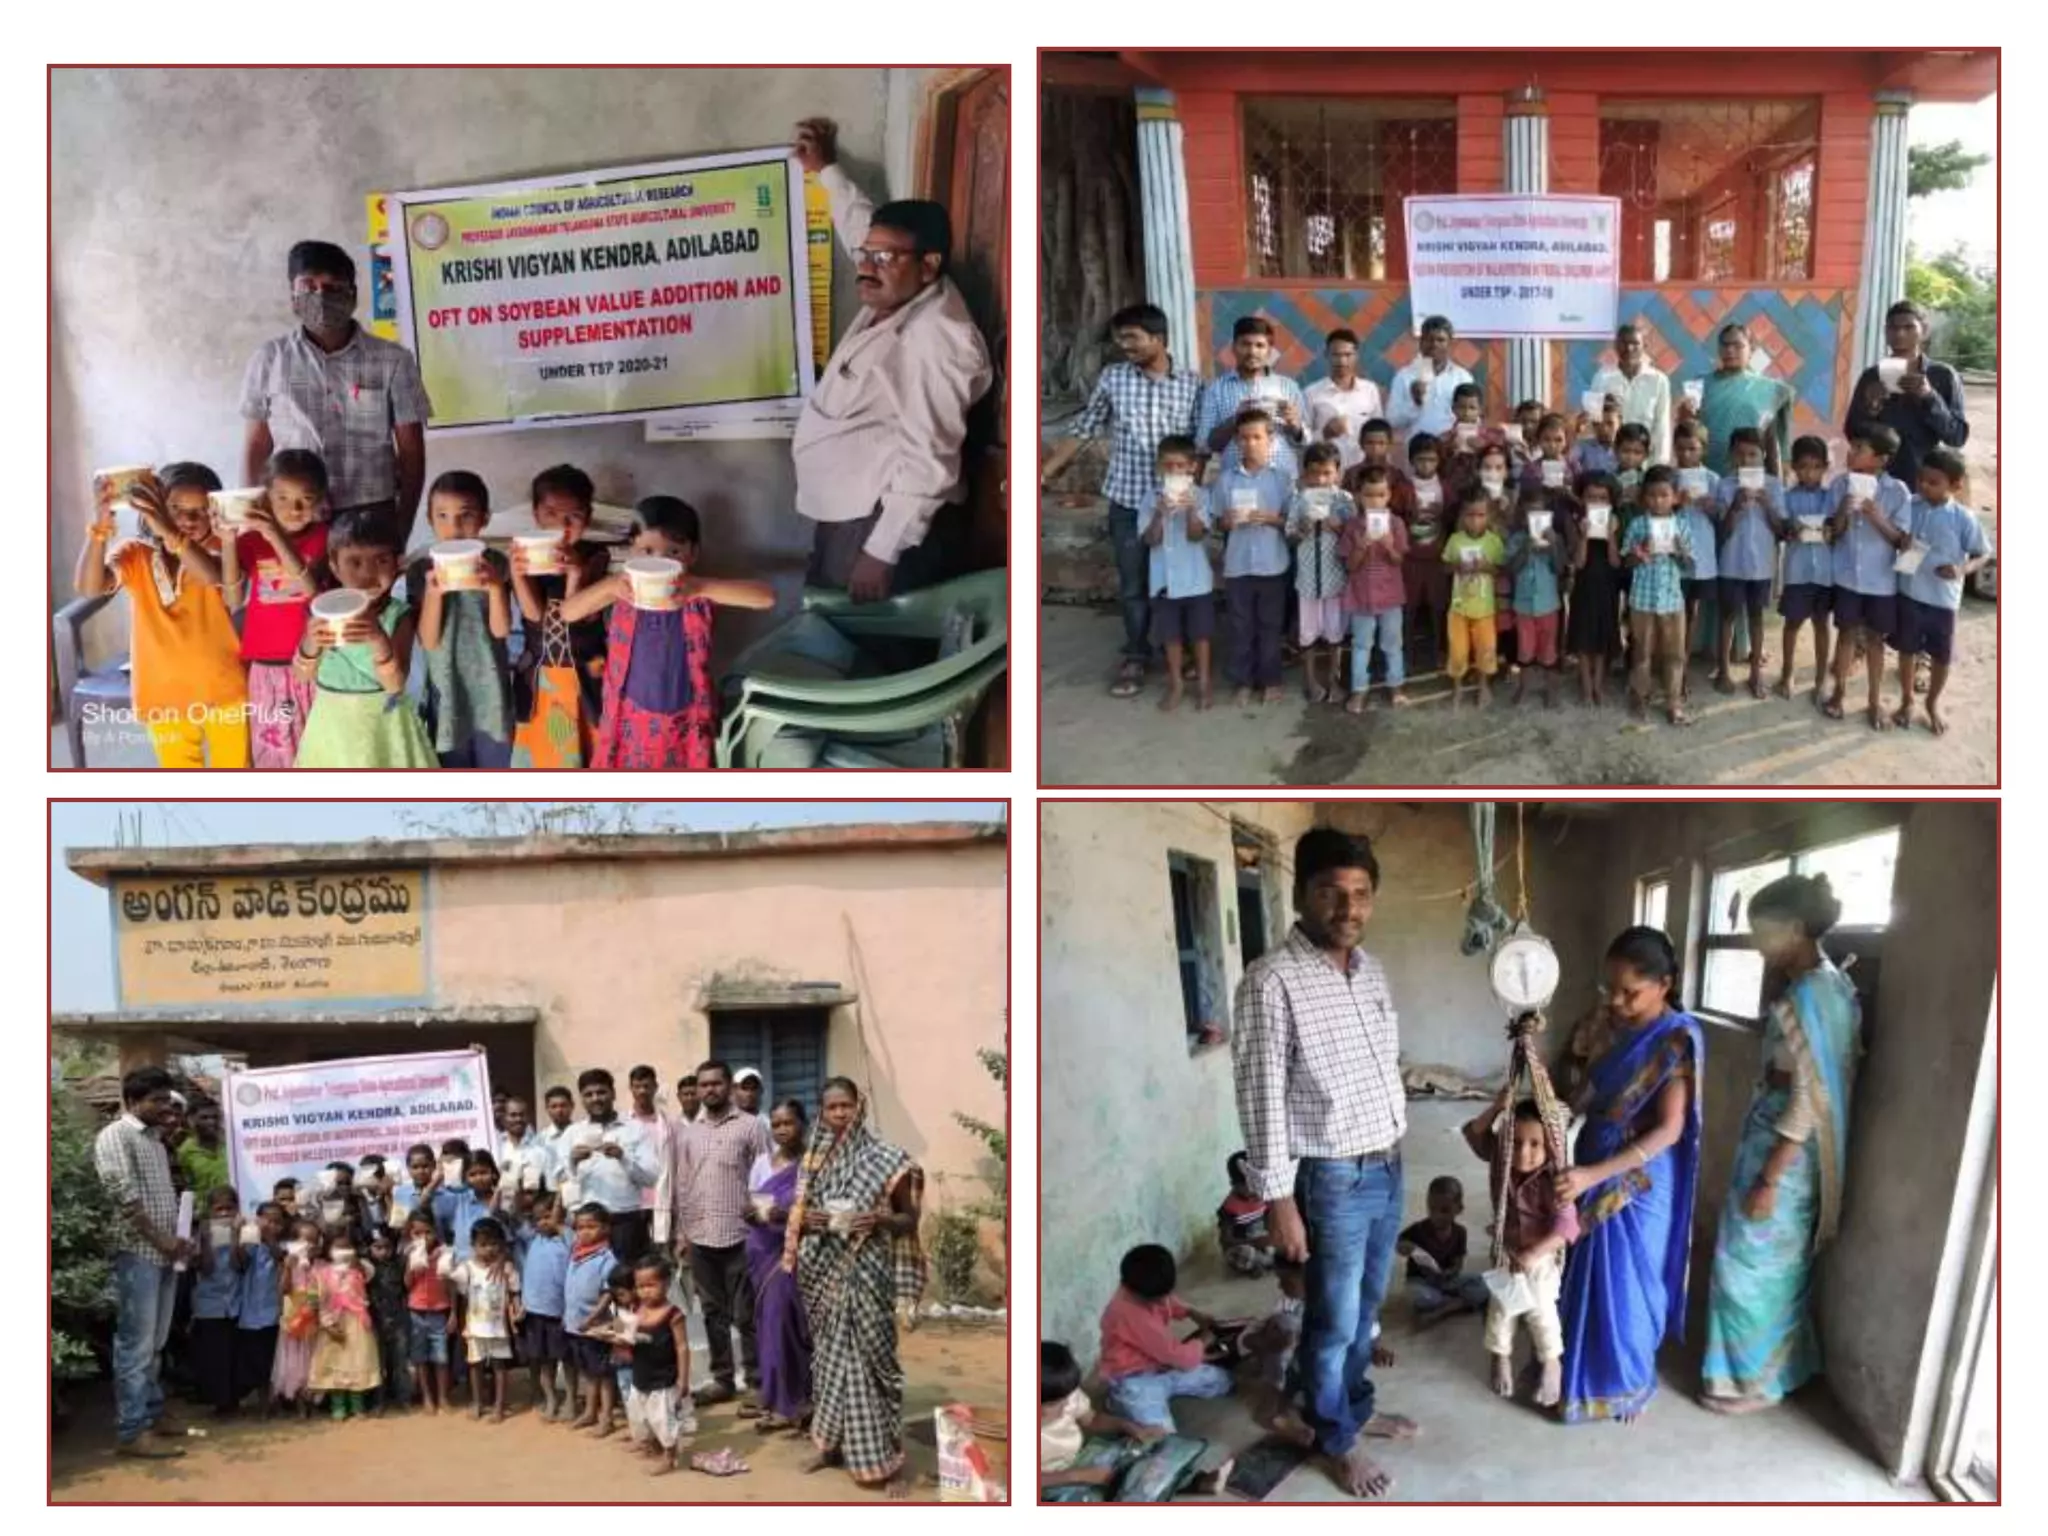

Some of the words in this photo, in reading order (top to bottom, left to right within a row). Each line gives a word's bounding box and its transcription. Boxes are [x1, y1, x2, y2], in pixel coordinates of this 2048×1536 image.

[441, 257, 503, 285] KRISHI
[508, 251, 575, 280] VIGYAN
[666, 228, 760, 261] ADILABAD
[428, 306, 461, 328] OFT
[468, 304, 492, 325] ON
[497, 297, 581, 321] SOYBEAN
[585, 290, 644, 313] VALUE
[650, 282, 739, 308] ADDITION
[744, 275, 782, 297] AND
[518, 314, 692, 350] SUPPLEMENTATION
[540, 363, 585, 380] UNDER
[619, 356, 669, 375] 2020-21
[122, 878, 222, 922] అంగన్
[296, 875, 411, 924] కేంద్రము
